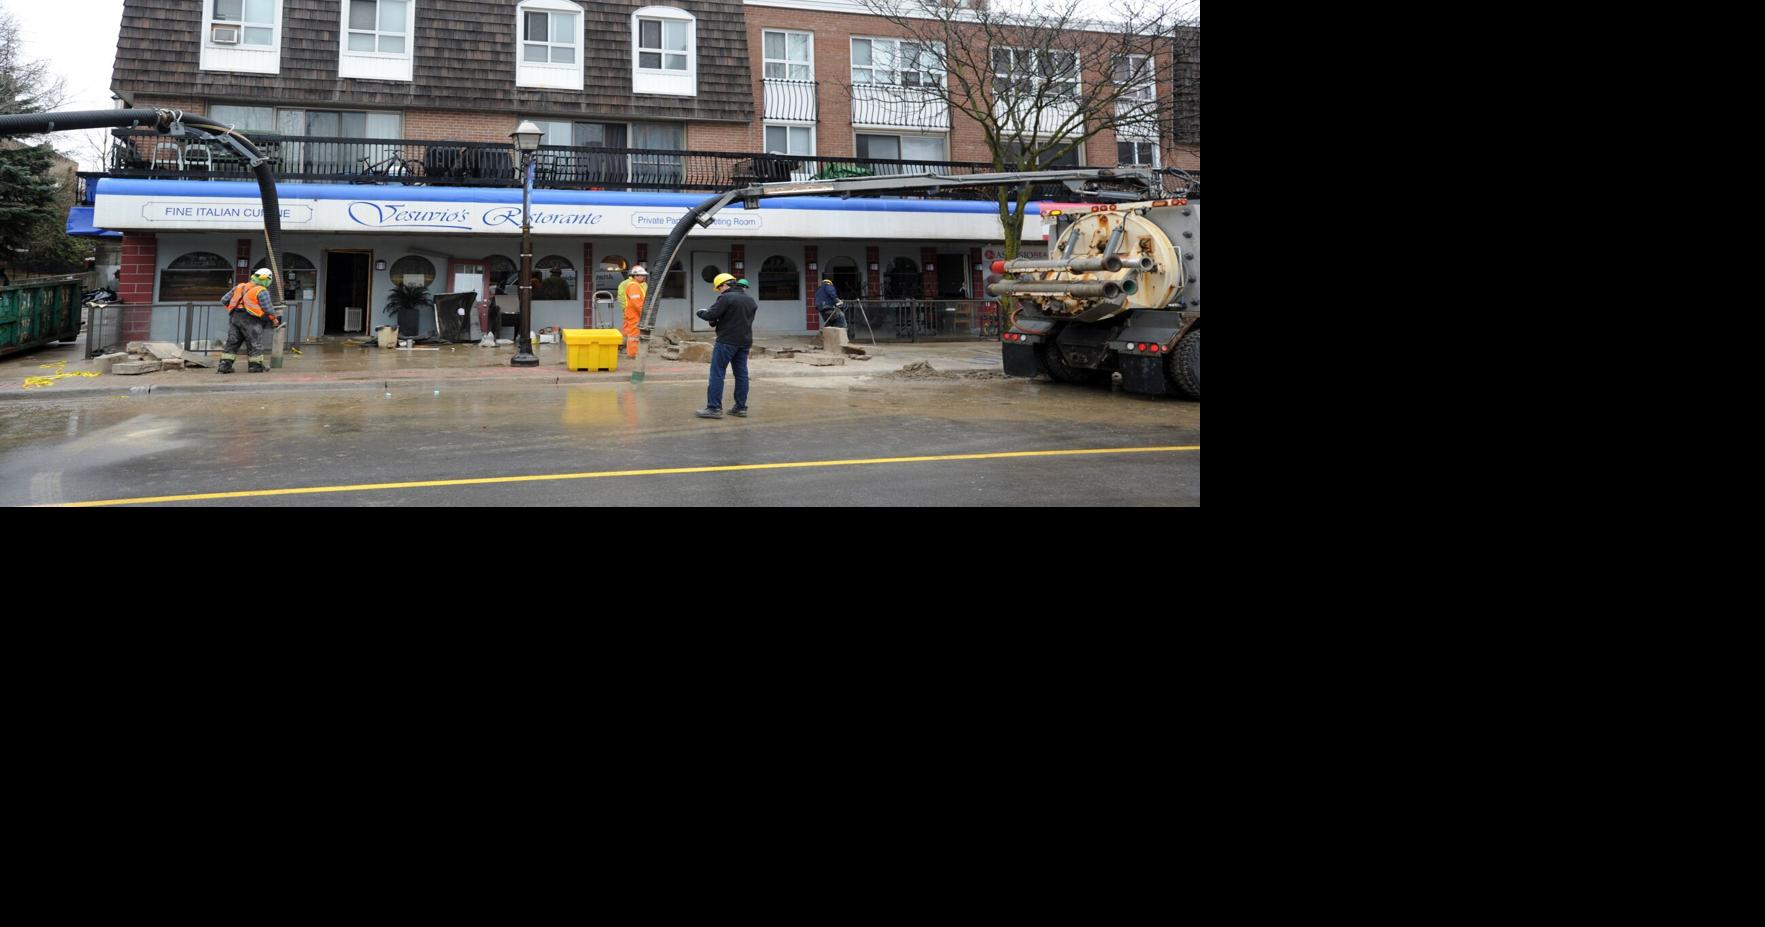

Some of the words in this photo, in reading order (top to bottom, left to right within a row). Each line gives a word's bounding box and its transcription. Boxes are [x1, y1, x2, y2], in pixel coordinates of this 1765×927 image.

[165, 207, 193, 217] FINE
[196, 208, 240, 217] ITALIAN
[243, 208, 291, 218] CUIE
[348, 201, 472, 230] Vesuvio's
[482, 206, 602, 226] Rstorante
[637, 216, 665, 225] Private
[733, 217, 756, 226] Room
